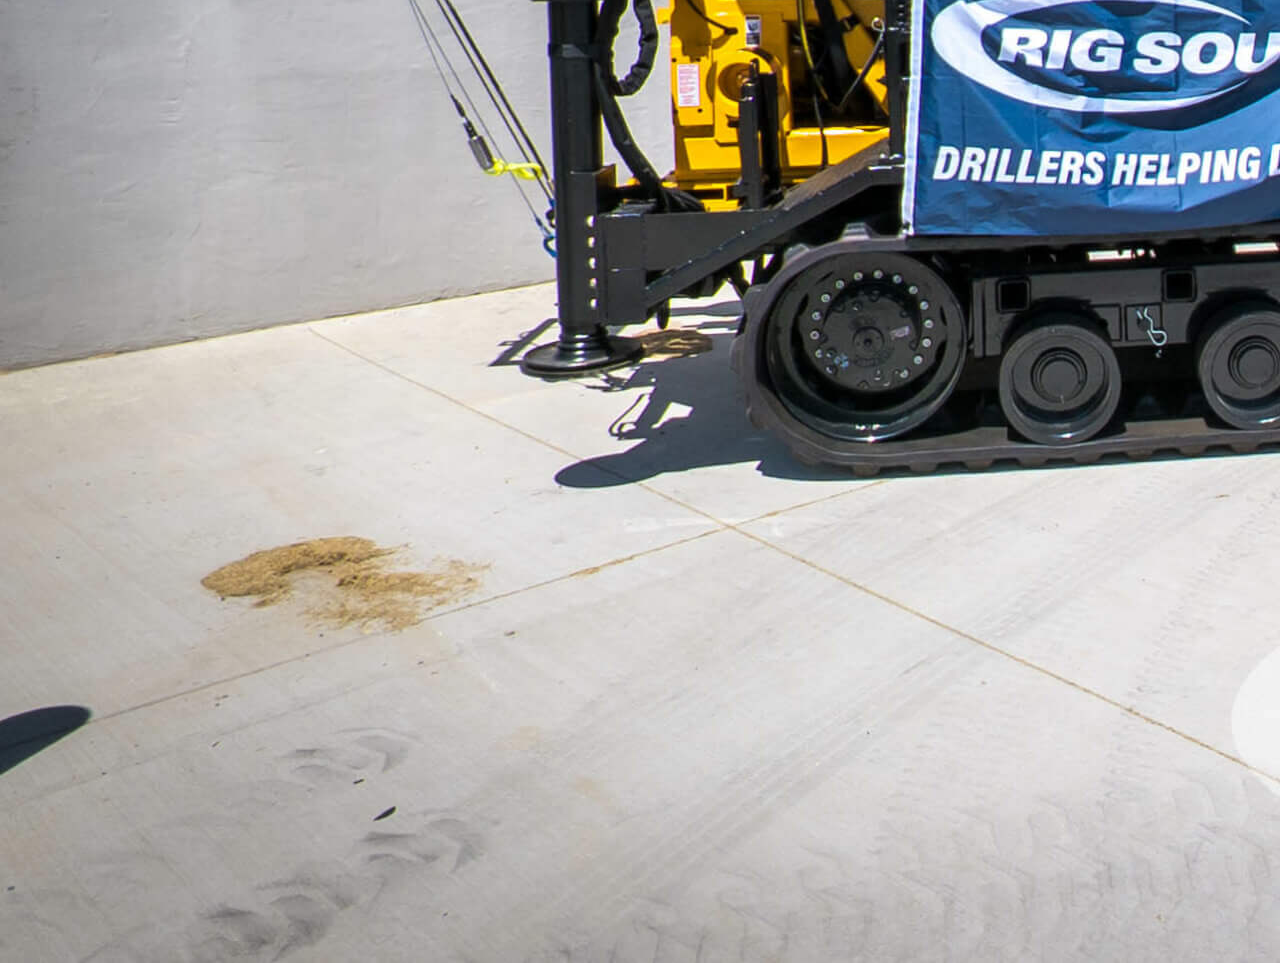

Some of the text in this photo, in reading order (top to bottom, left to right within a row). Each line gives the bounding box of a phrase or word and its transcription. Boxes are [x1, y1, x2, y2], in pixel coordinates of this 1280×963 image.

[998, 27, 1123, 73] RIG
[933, 146, 1104, 185] DRILLERS
[1111, 147, 1261, 186] HELPING
